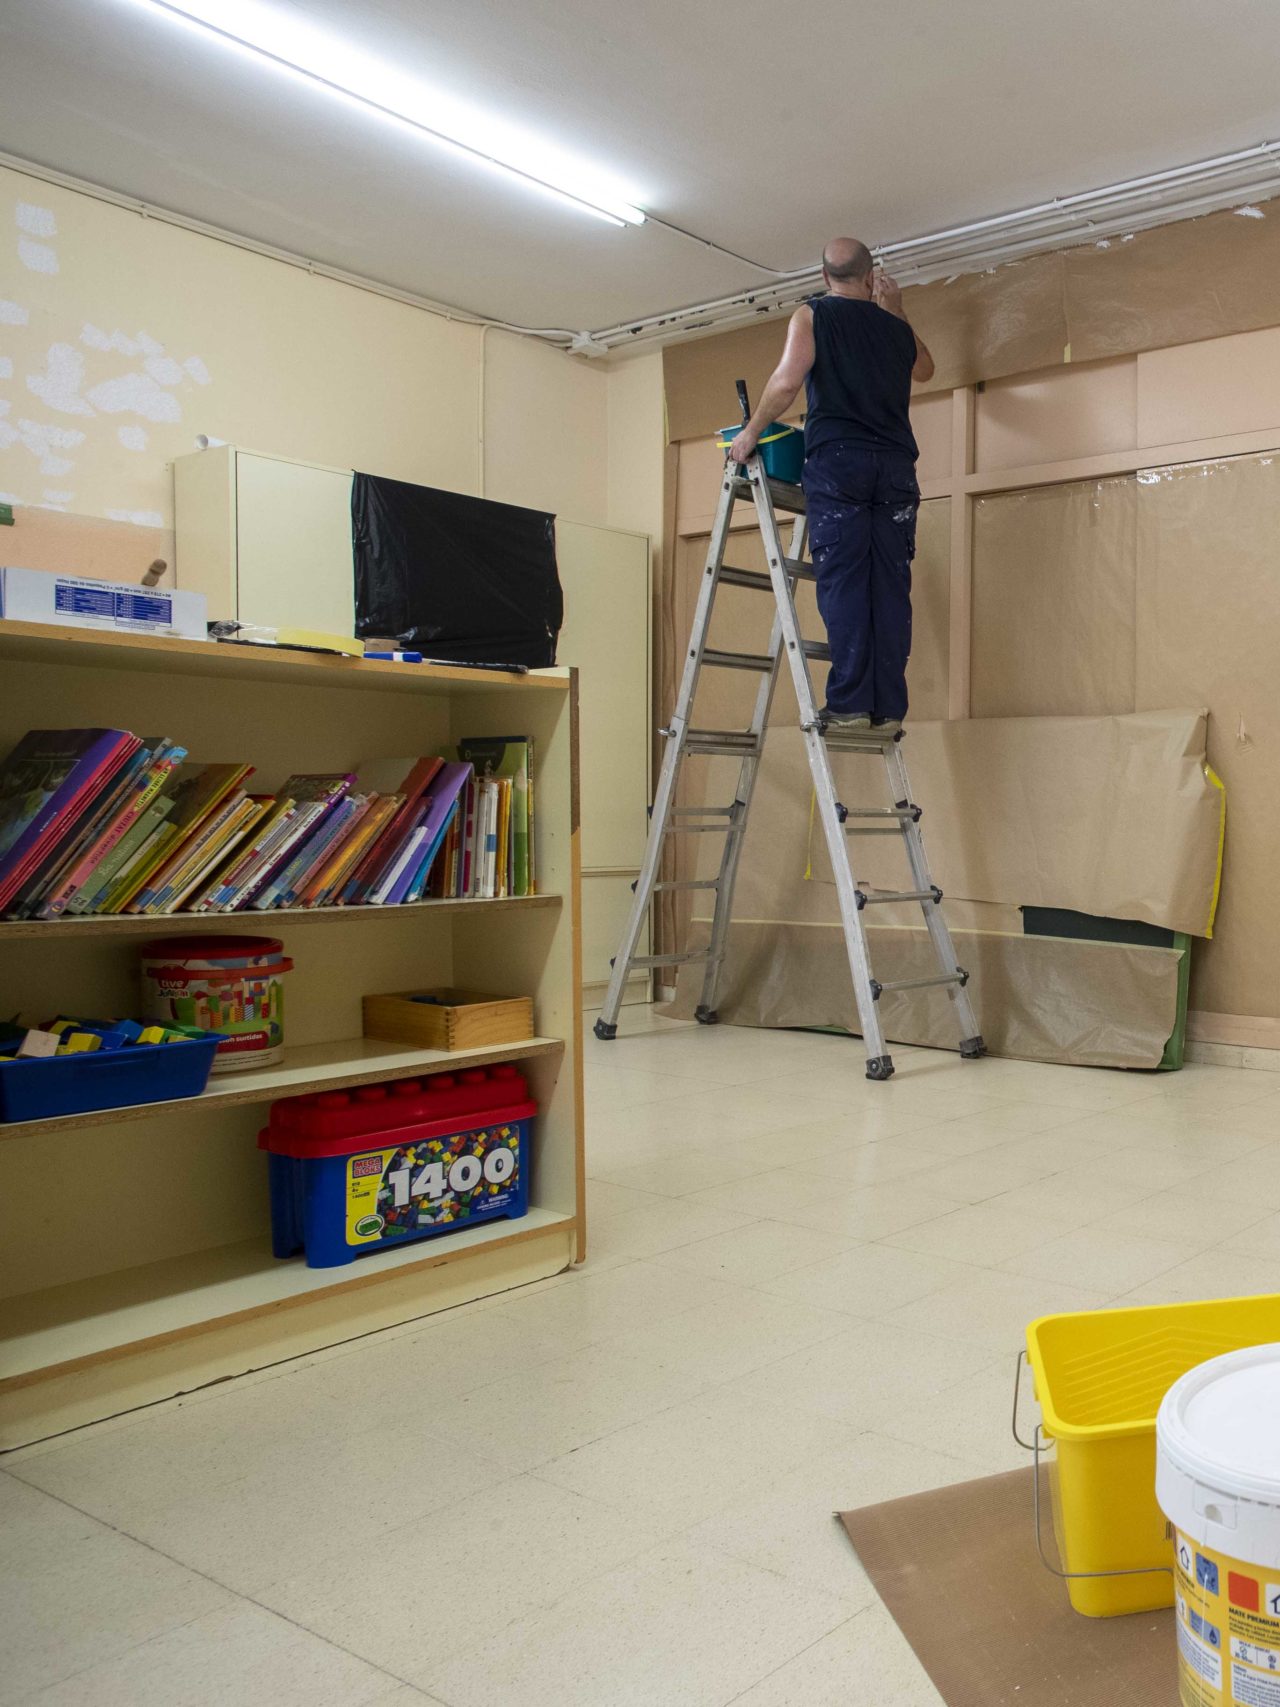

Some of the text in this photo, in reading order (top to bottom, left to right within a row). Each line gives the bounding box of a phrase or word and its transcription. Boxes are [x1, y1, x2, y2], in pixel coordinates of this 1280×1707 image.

[353, 1165, 382, 1177] BLOKS
[354, 1157, 381, 1169] MEGA
[388, 1147, 515, 1207] 1400
[1229, 1608, 1280, 1628] MATE PREMIUM
